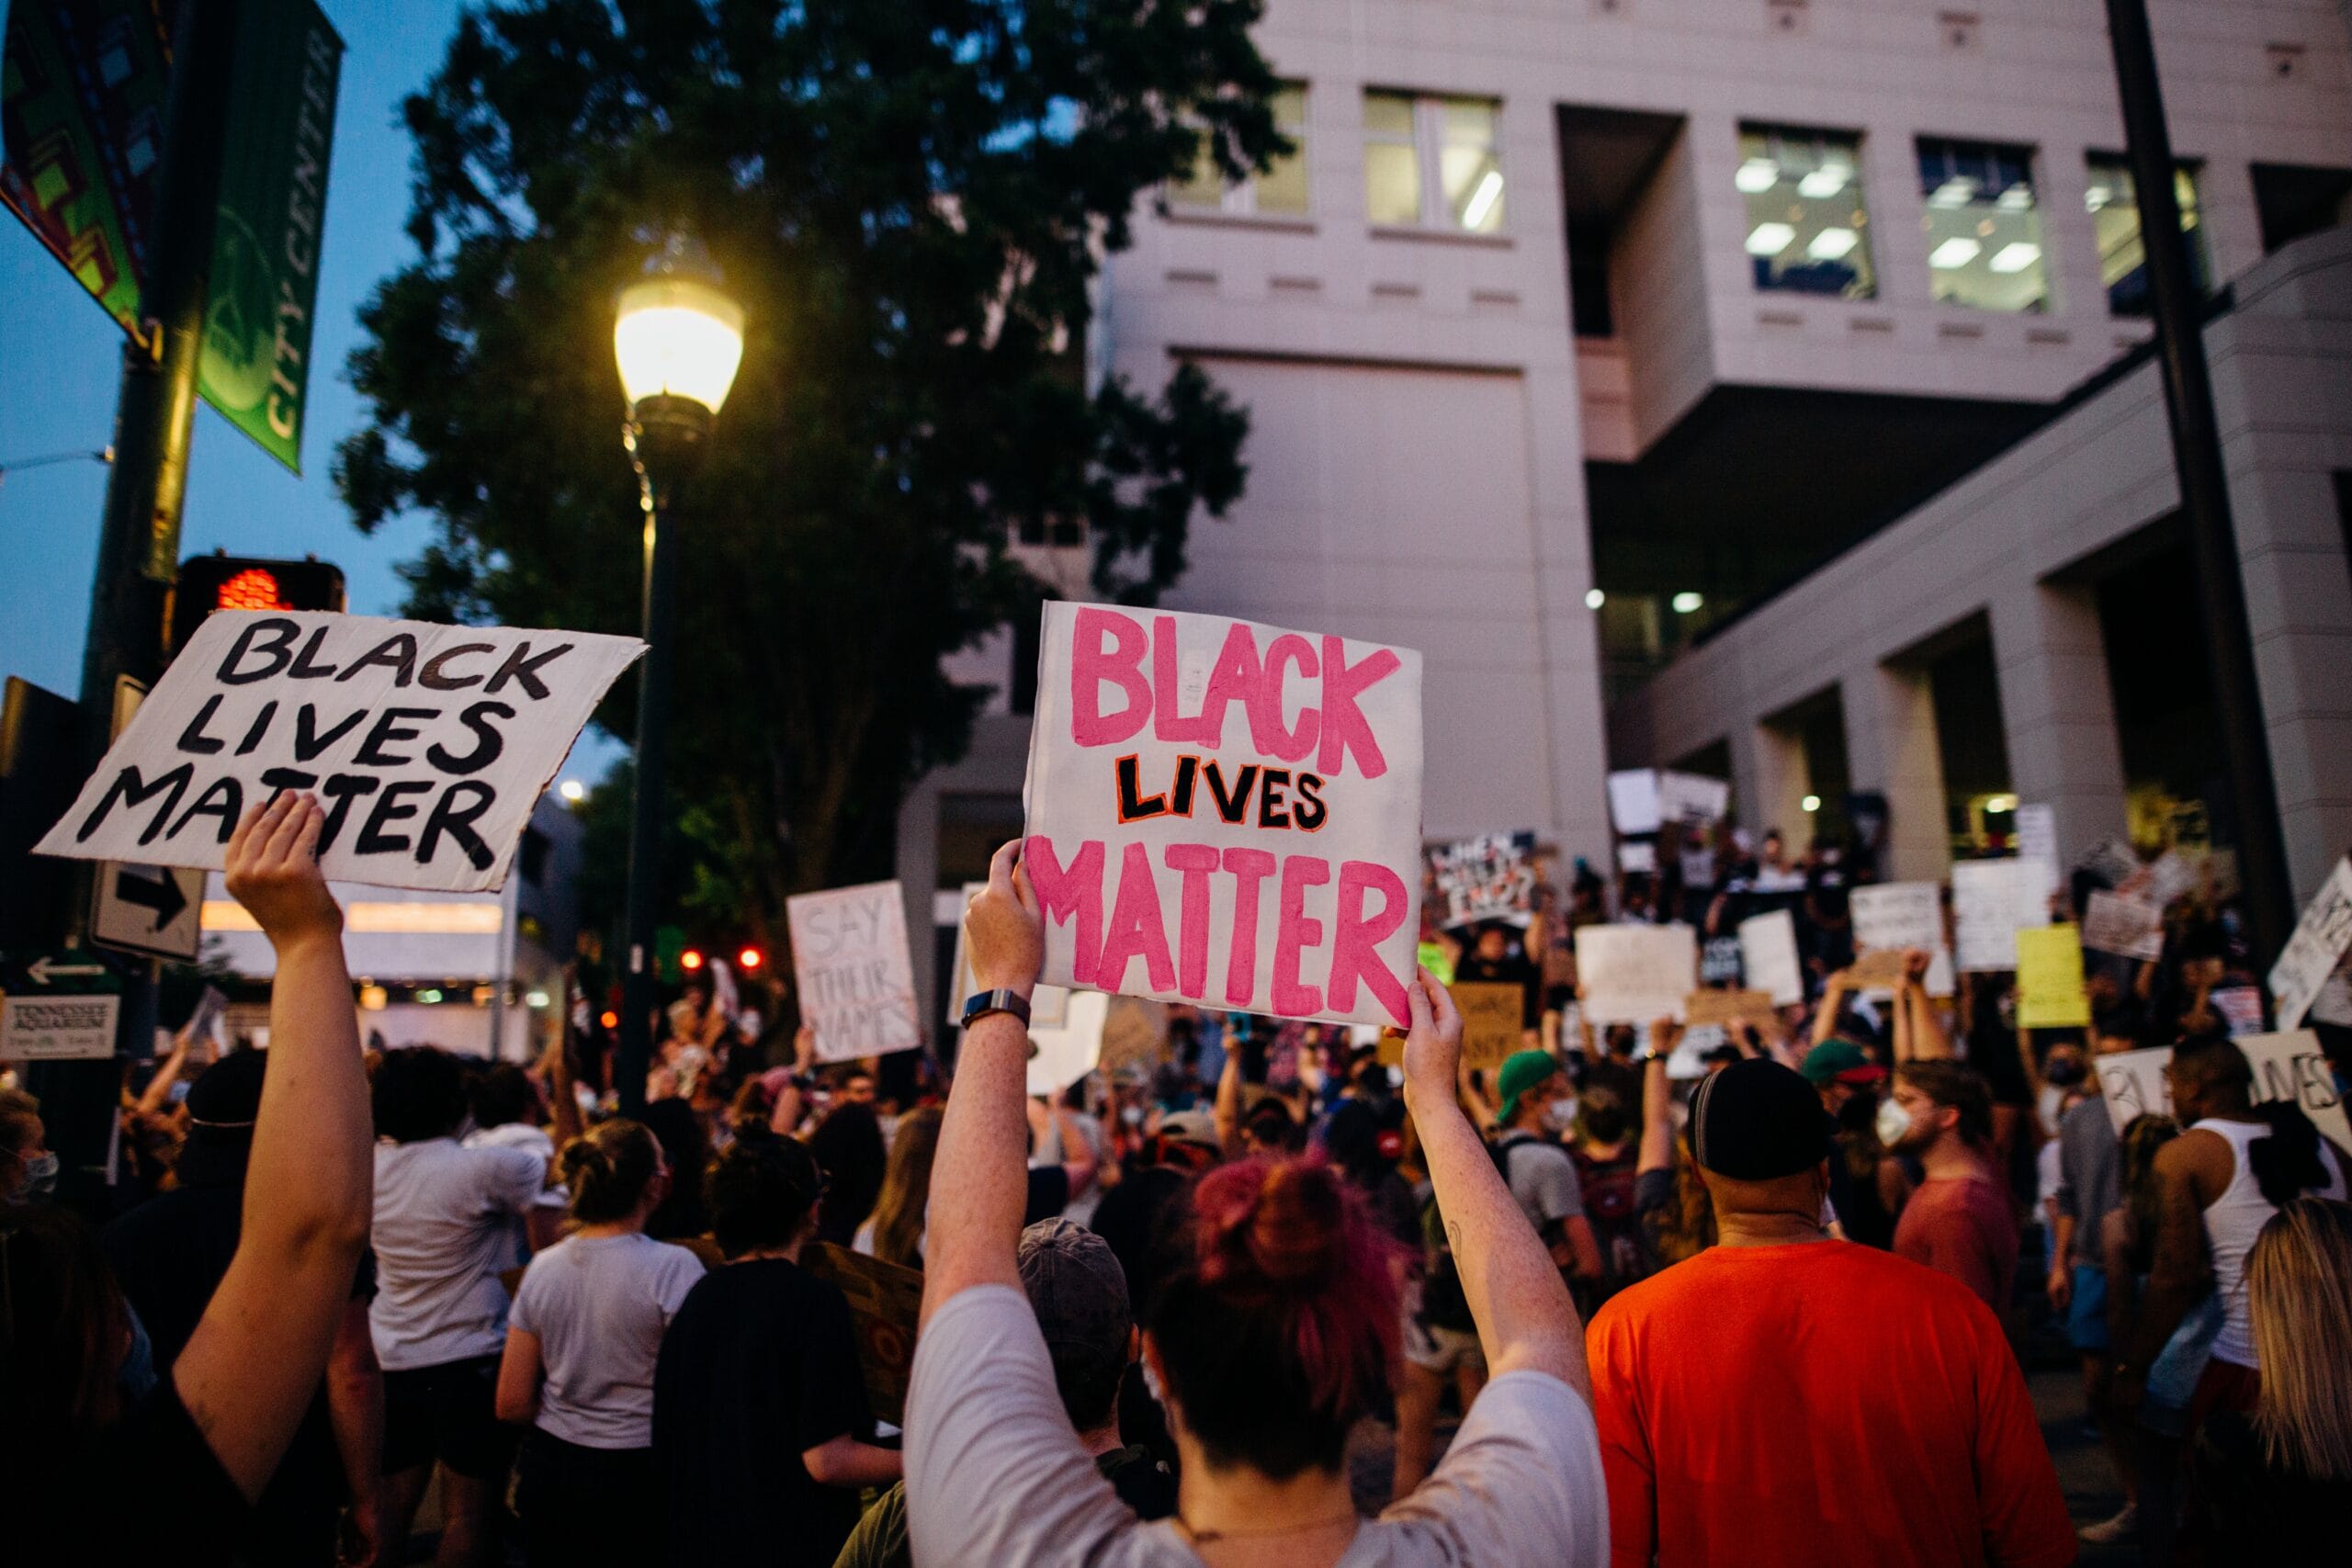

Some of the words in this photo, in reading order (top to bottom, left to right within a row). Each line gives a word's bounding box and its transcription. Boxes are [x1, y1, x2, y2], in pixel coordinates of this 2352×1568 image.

[266, 282, 303, 439] CITY
[286, 27, 334, 276] CENTER
[216, 618, 574, 700] BLACK
[1071, 606, 1402, 780] BLACK
[176, 694, 515, 774] LIVES
[1115, 753, 1329, 832] LIVES
[805, 897, 885, 957] SAY
[1024, 835, 1412, 1030] MATTER
[13, 1003, 107, 1017] TENNESSEE
[808, 959, 900, 1007] THEIR
[13, 1016, 105, 1031] AQUARIUM
